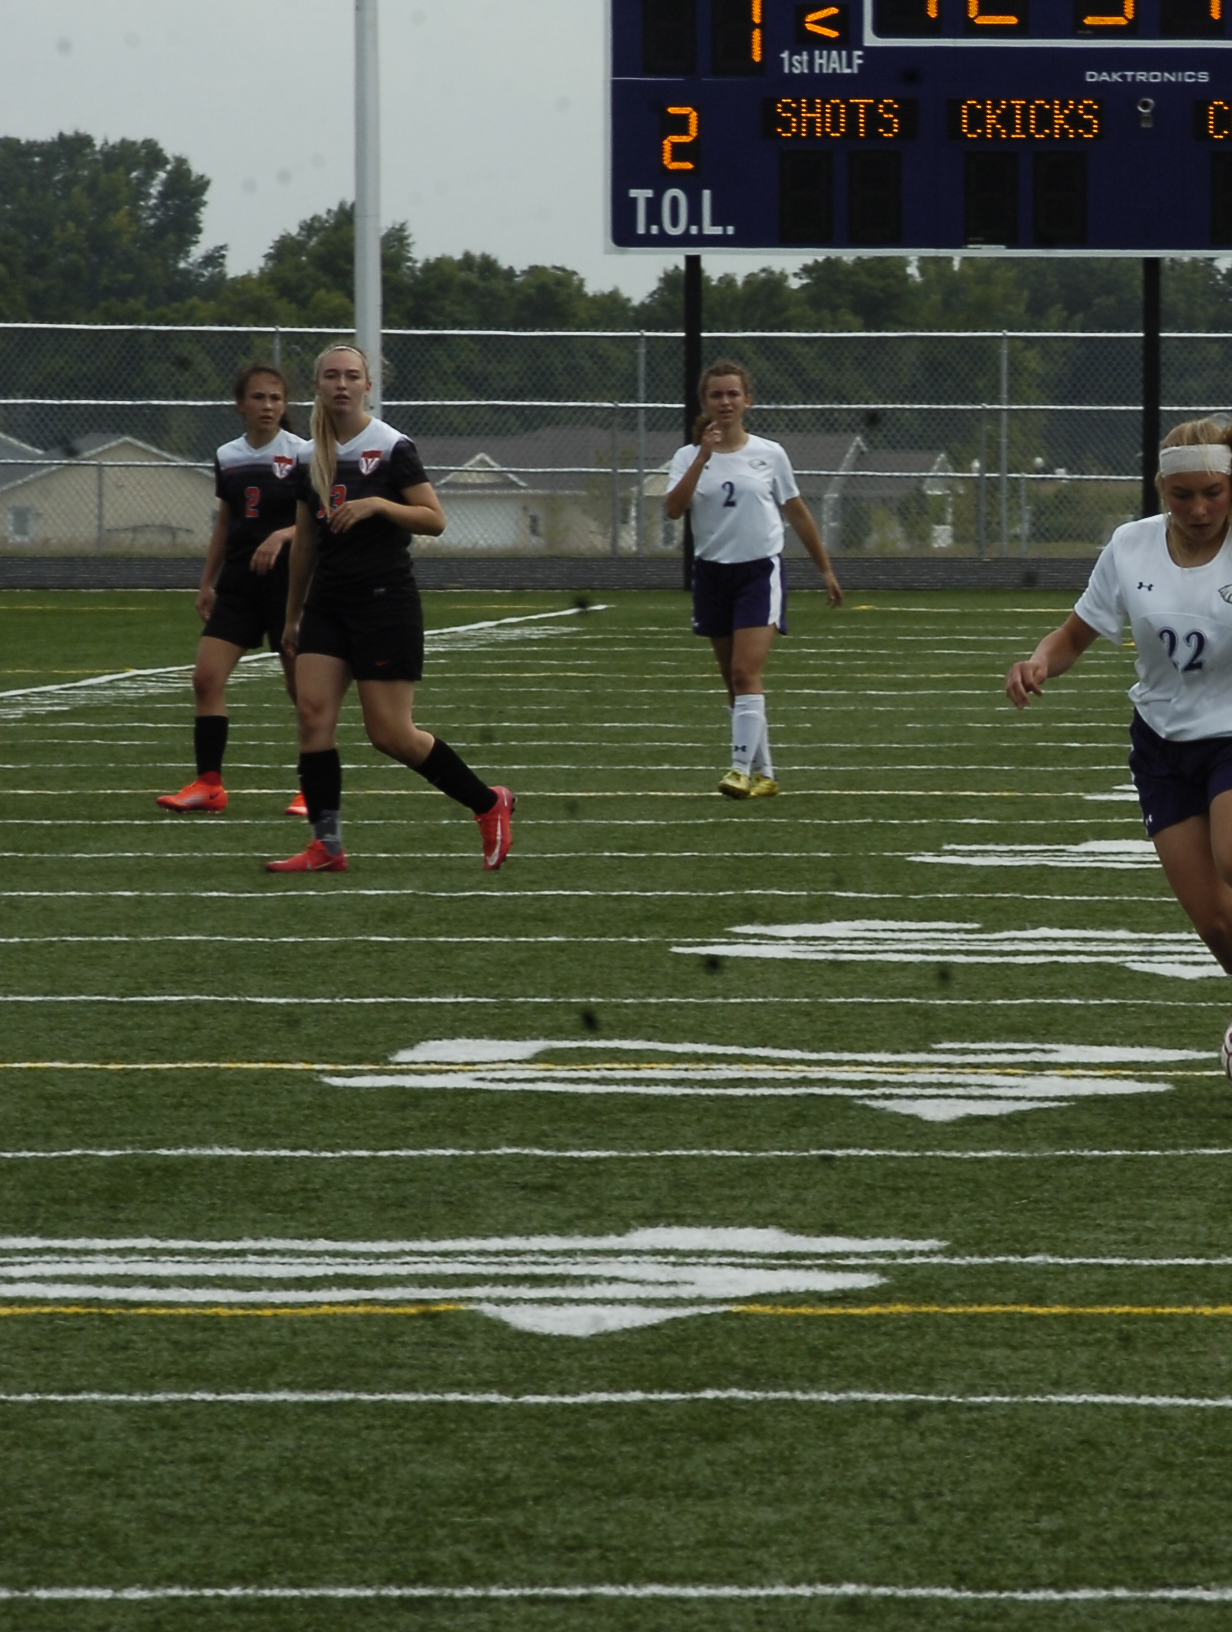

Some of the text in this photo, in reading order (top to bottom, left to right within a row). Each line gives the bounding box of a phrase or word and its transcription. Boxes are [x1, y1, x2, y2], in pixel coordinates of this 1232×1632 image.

[780, 50, 864, 74] 1st HALF
[1085, 71, 1210, 83] DAKTRONICS
[776, 98, 900, 137] SHOTS
[961, 99, 1099, 138] CKICKS
[662, 106, 698, 169] 2
[628, 188, 735, 236] T.O.L.
[244, 486, 260, 518] 2
[722, 481, 736, 508] 2
[1158, 626, 1207, 673] 22
